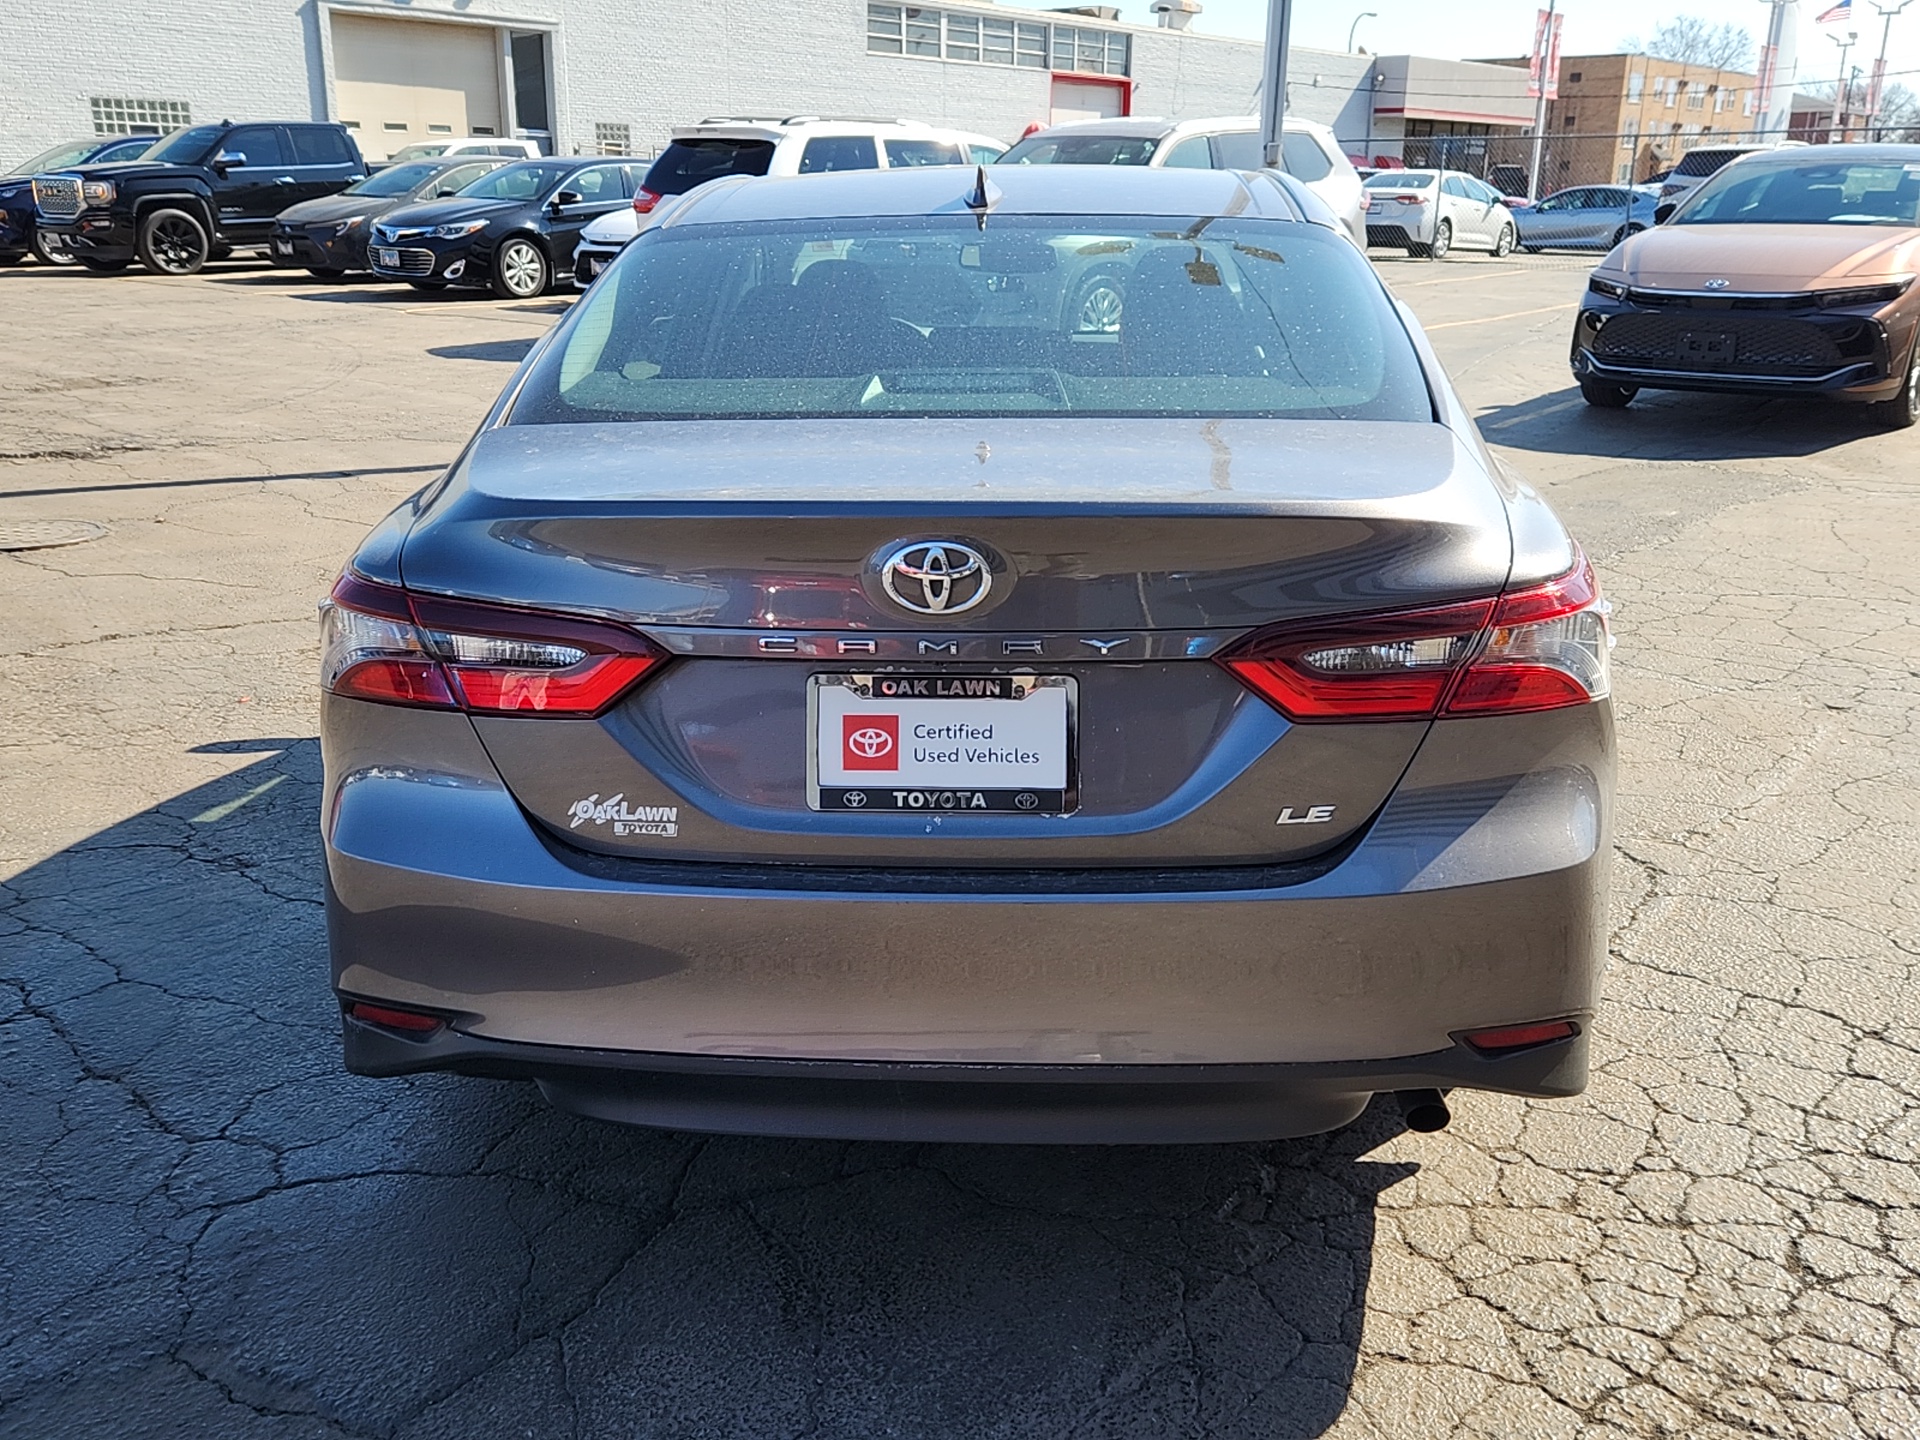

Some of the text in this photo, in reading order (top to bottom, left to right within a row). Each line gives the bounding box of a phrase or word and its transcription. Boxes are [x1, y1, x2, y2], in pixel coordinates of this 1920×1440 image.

[758, 636, 1130, 655] CAMRY
[881, 679, 1001, 696] OAK LAWN
[913, 724, 993, 740] Certified
[913, 748, 1040, 764] Used Vehicles
[892, 791, 988, 808] TOYOTA
[1276, 805, 1337, 825] LE
[620, 822, 669, 833] TOYOTA
